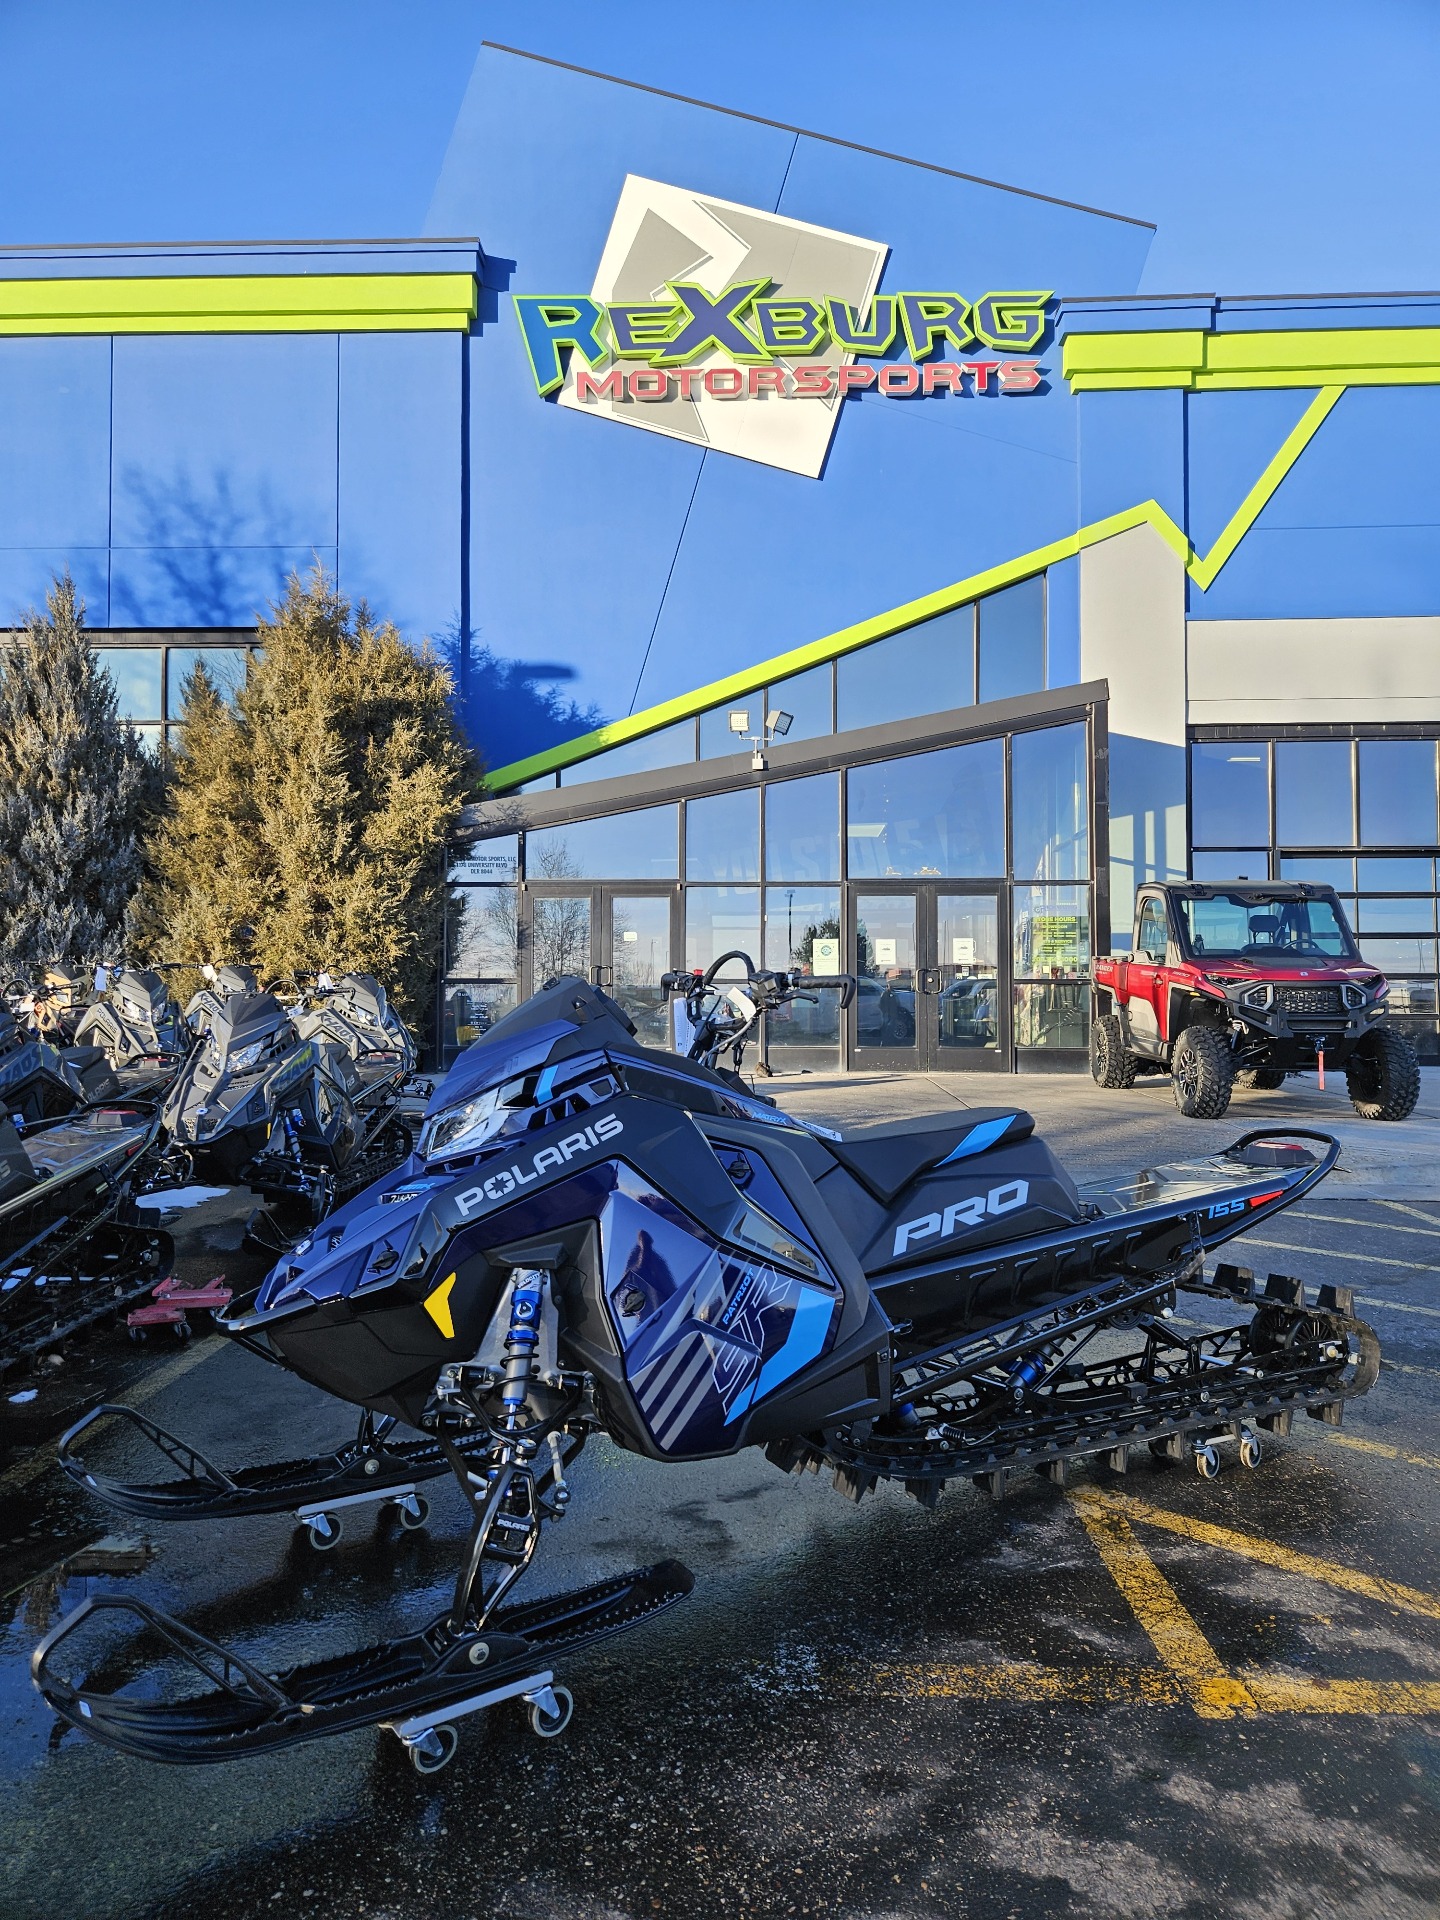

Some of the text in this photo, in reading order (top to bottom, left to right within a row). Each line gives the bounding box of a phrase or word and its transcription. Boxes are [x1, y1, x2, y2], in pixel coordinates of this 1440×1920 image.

[511, 277, 1056, 398] REXBURG
[576, 360, 1043, 402] MOTORSPORTS
[97, 1007, 118, 1034] POLARIS
[315, 1010, 357, 1043] KHAOS
[752, 1111, 787, 1125] MATRYX
[454, 1113, 624, 1217] POLARIS
[893, 1179, 1029, 1257] PRO
[1208, 1197, 1245, 1219] 155
[722, 1267, 754, 1325] PATRIOT
[497, 1518, 530, 1531] POLARIS
